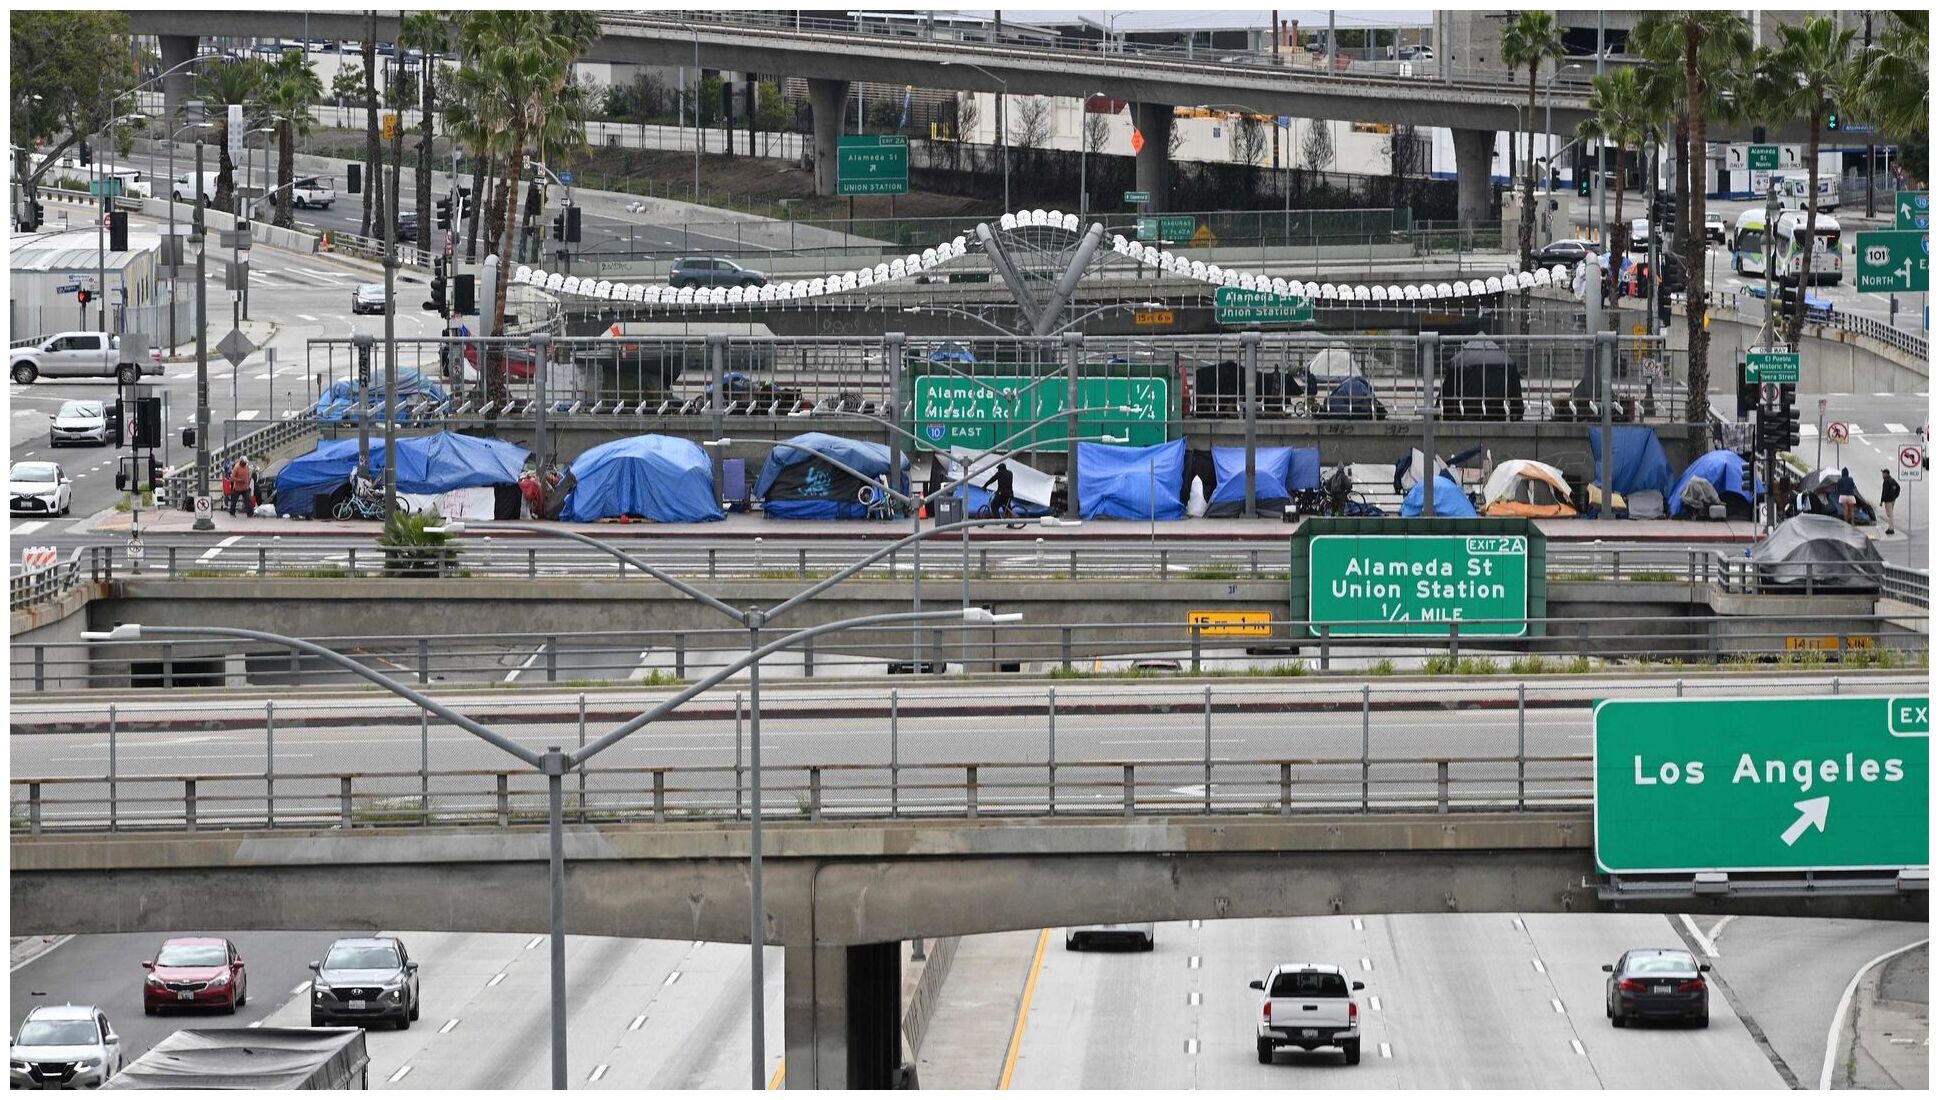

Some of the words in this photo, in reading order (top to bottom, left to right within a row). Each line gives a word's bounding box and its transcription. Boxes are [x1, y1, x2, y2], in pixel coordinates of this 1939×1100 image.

[844, 183, 868, 191] UNION
[870, 183, 902, 191] STATION
[1869, 251, 1885, 261] 101
[1920, 259, 1929, 270] E
[1861, 275, 1894, 286] NORTH
[1225, 292, 1274, 303] Alameda
[929, 386, 994, 399] Alameda
[926, 406, 985, 418] Mission
[931, 428, 940, 437] 10
[951, 427, 982, 437] EAST
[1469, 540, 1494, 550] EXIT
[1499, 538, 1524, 553] 2A
[1345, 557, 1453, 577] Alameda
[1467, 558, 1493, 577] St
[1332, 580, 1401, 598] Union
[1416, 580, 1505, 599] Station
[1421, 608, 1463, 622] MILE
[1194, 617, 1210, 629] 15
[1794, 638, 1806, 649] 14
[1634, 755, 1705, 785] Los
[1731, 752, 1904, 792] Angeles
